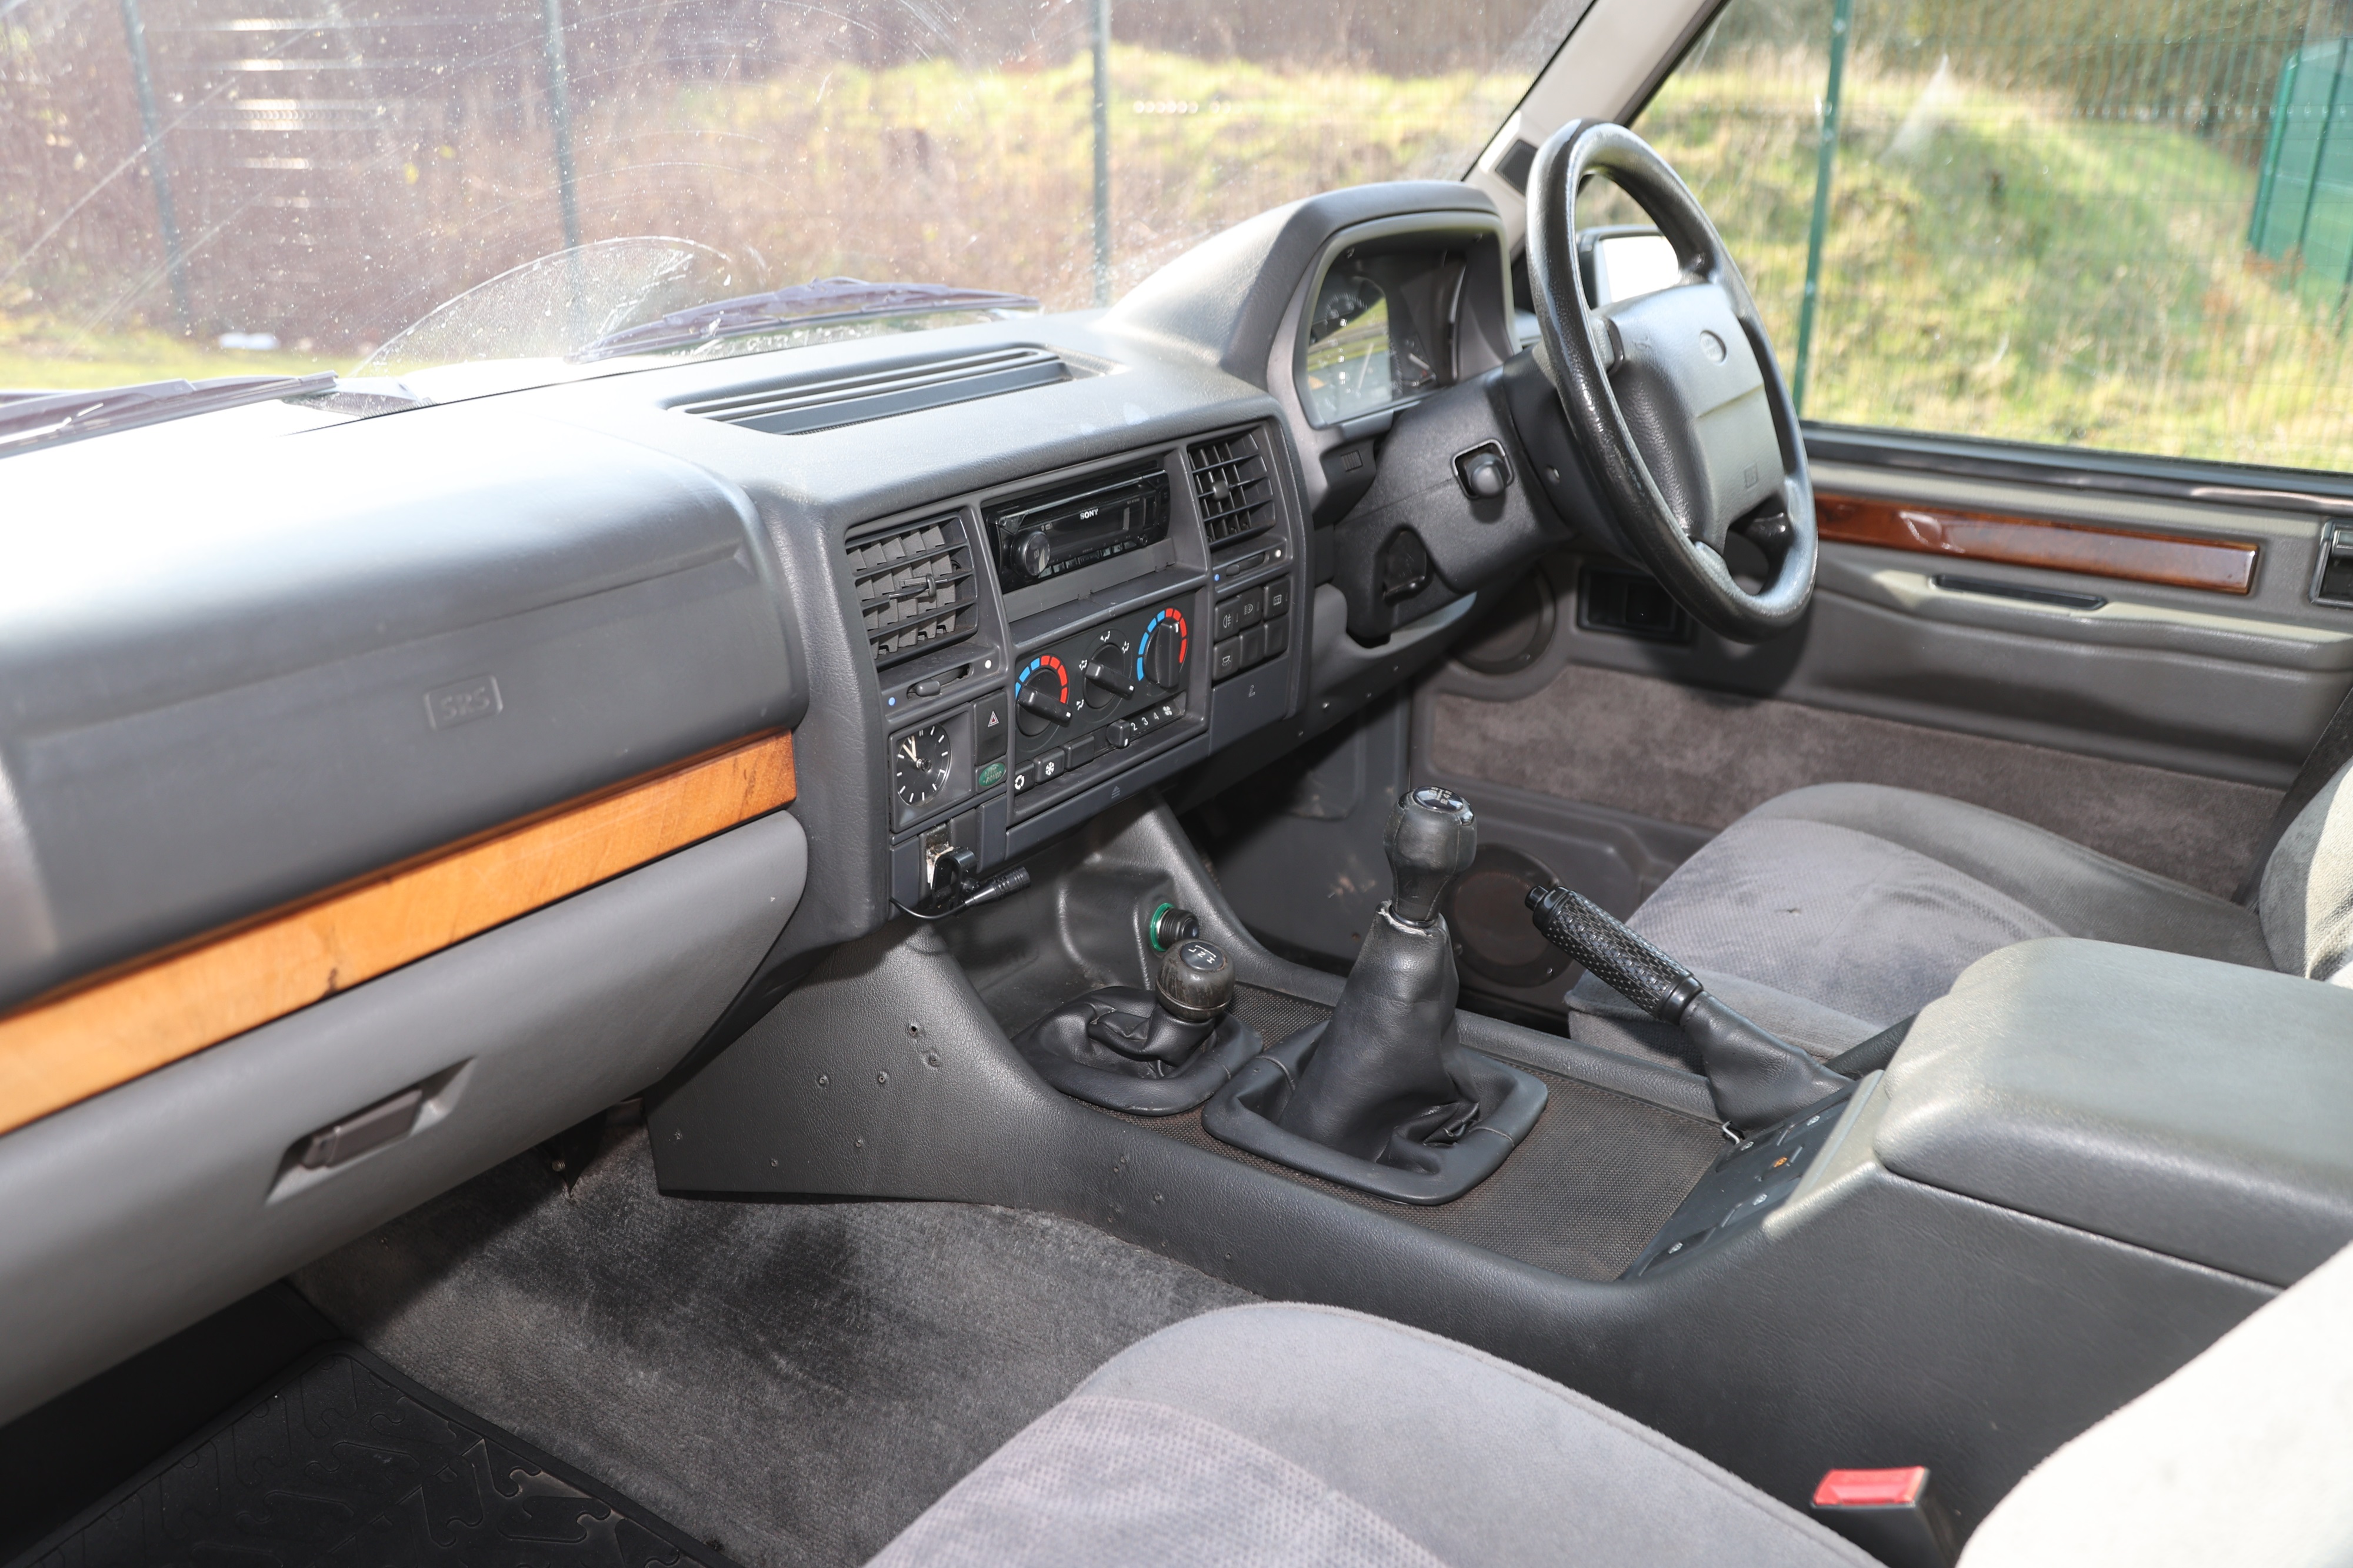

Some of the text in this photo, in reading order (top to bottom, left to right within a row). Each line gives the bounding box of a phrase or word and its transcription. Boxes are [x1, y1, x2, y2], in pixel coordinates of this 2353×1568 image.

[1080, 508, 1099, 521] SONY
[439, 686, 490, 721] SRS
[1131, 712, 1159, 731] 2 3 4
